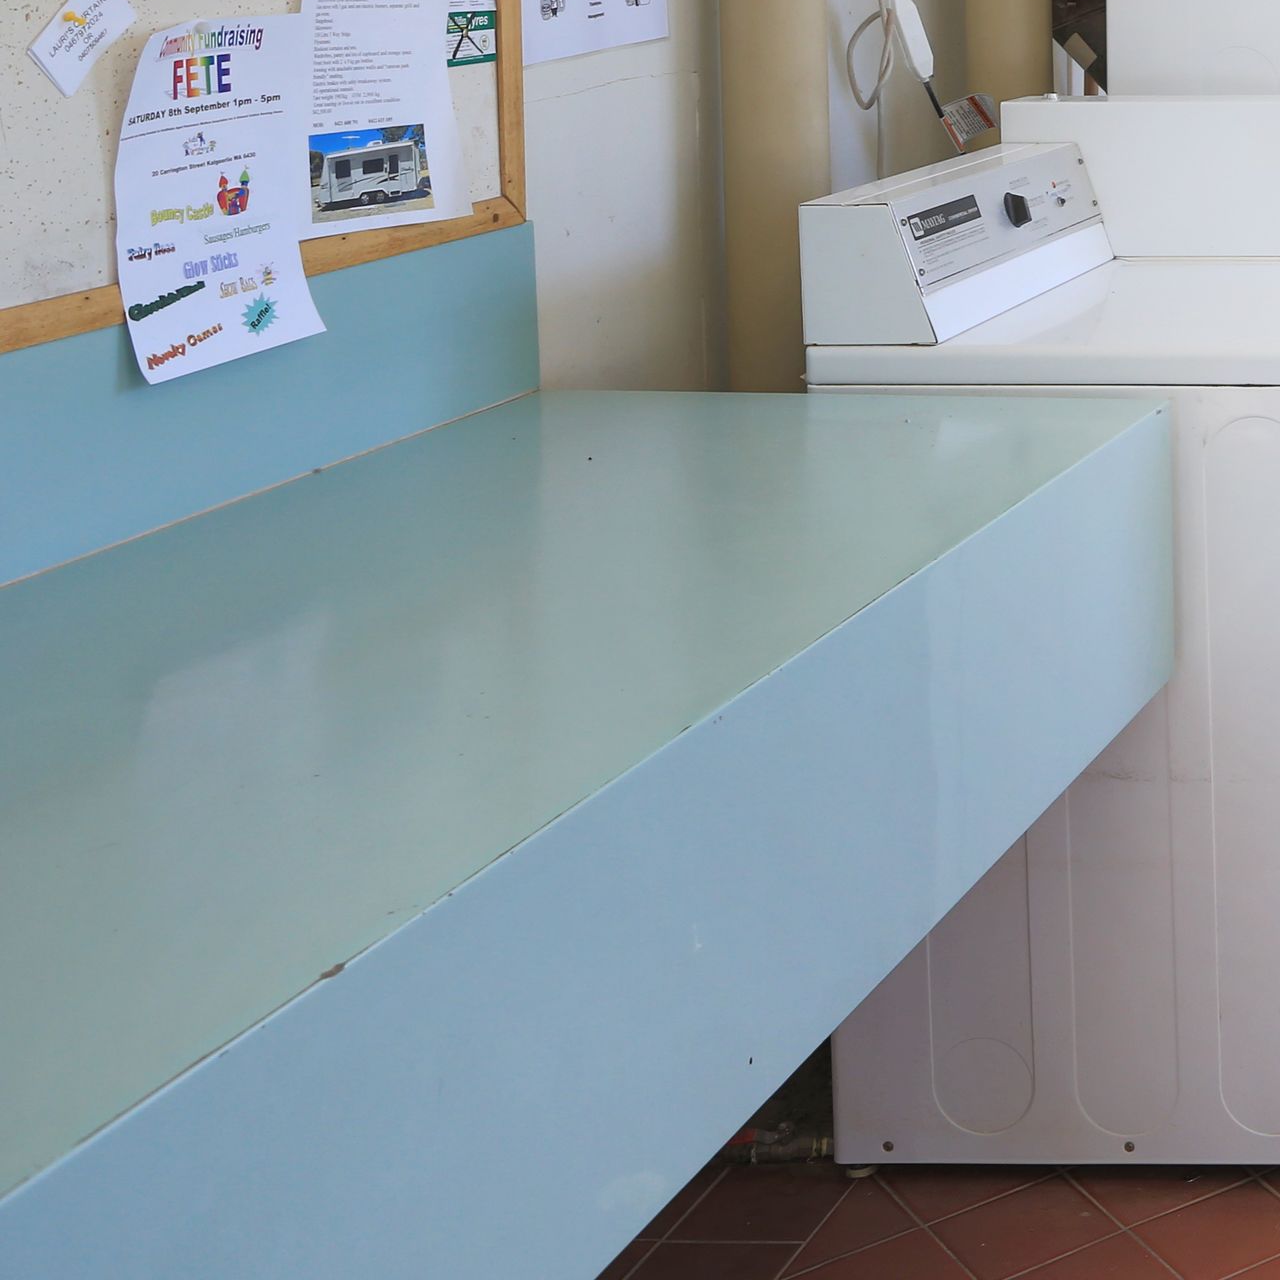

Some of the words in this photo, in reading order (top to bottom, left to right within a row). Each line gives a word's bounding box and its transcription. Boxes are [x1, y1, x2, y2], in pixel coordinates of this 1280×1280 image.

[198, 24, 264, 50] Fundraising
[172, 53, 232, 101] FETE
[128, 110, 166, 126] SATURDAY
[168, 106, 182, 118] 8th
[184, 100, 230, 115] September
[233, 97, 252, 108] 1pm
[260, 94, 281, 106] 5pm
[189, 161, 206, 170] Street
[151, 208, 184, 226] Bouncy
[186, 202, 214, 221] Castle
[183, 258, 208, 280] Glow
[210, 252, 239, 274] Sticks
[250, 302, 272, 330] Raffle!
